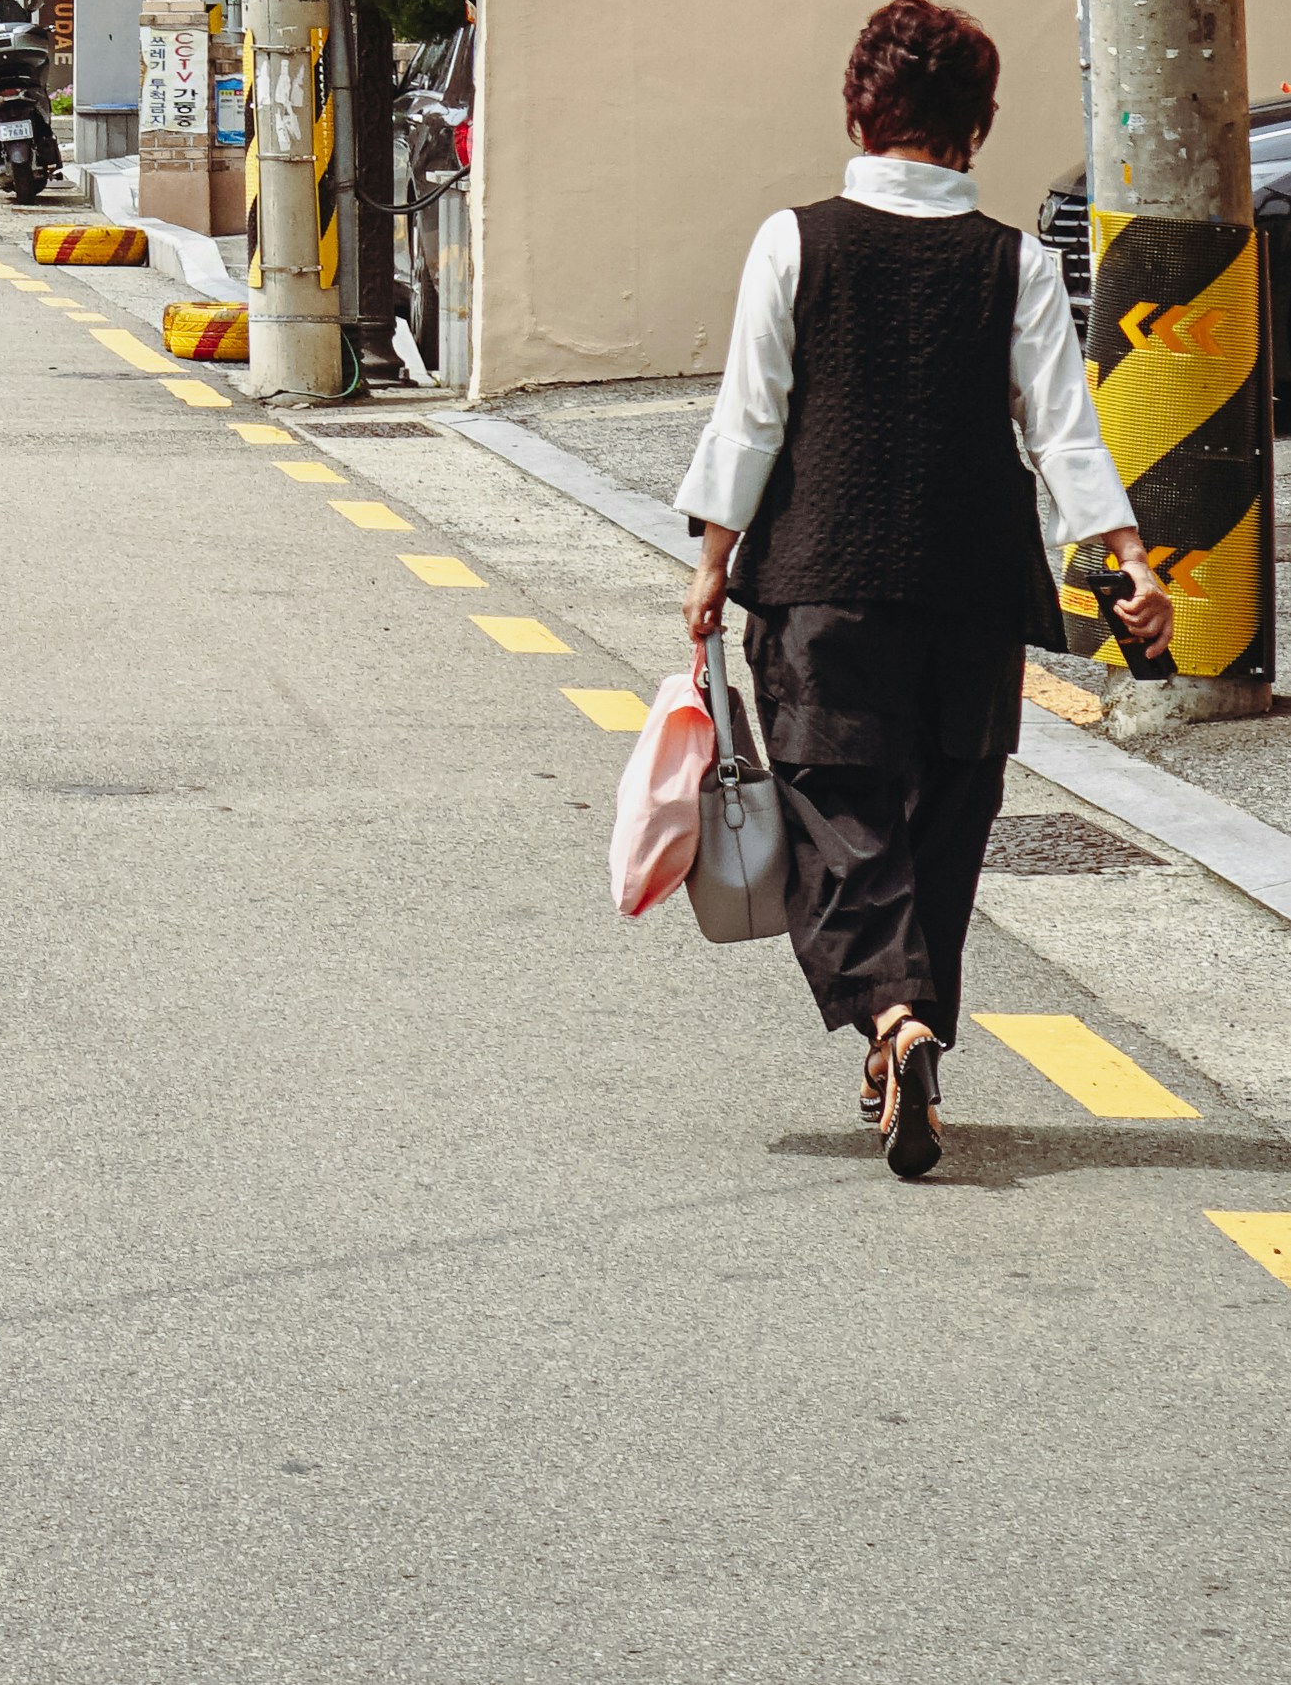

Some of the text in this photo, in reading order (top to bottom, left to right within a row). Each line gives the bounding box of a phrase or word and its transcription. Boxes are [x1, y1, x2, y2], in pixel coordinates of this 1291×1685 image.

[149, 36, 167, 126] 쓰레기 투척금지
[173, 32, 199, 128] CCTV 가동중
